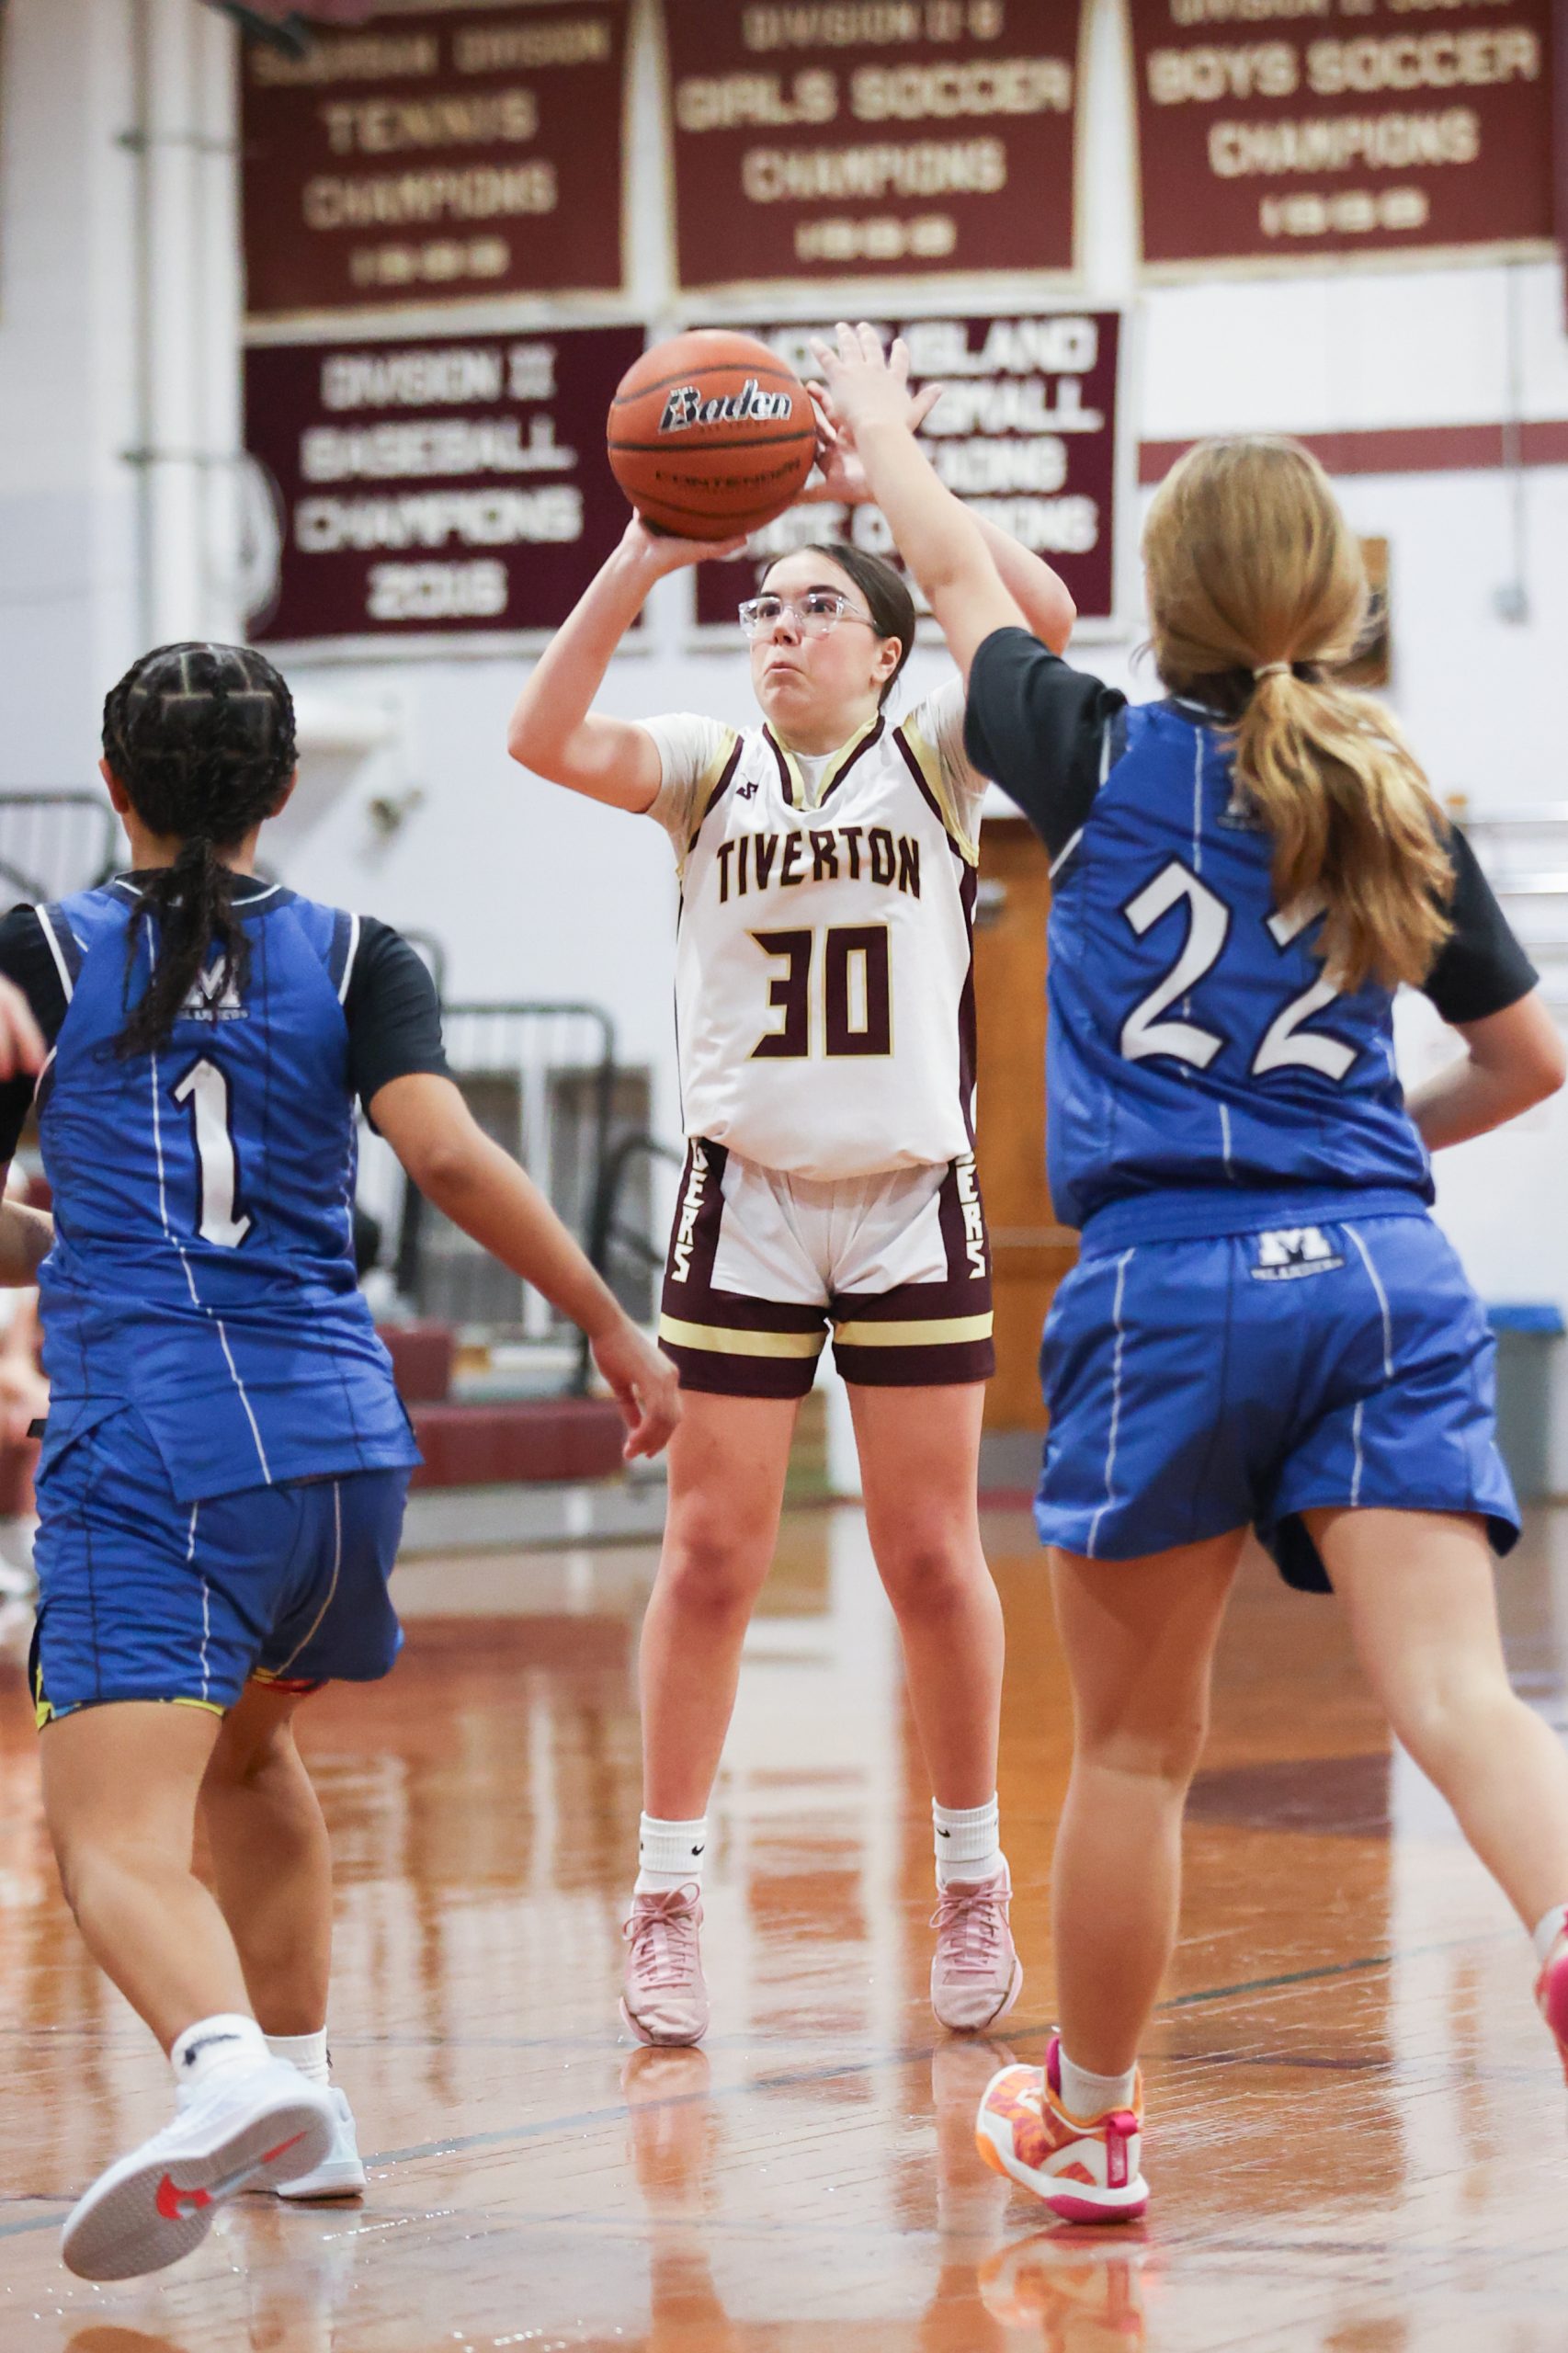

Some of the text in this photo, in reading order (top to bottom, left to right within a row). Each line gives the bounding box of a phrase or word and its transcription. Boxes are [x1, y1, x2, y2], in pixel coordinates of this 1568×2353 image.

[850, 57, 1071, 121] SOCCER
[1147, 26, 1540, 105] BOYS SOCCER
[743, 137, 1006, 203] CHAMPIONS
[1208, 107, 1480, 178] CHAMPIONS
[302, 160, 558, 230] CHAMPIONS
[320, 348, 502, 411] DIVISION
[658, 378, 792, 436] Baden
[301, 415, 577, 483] BASEBALL
[294, 484, 584, 552] CHAMPIONS
[716, 825, 922, 904] TIVERTON
[744, 921, 895, 1062] 30
[1121, 859, 1358, 1082] 22
[173, 1058, 251, 1249] 1
[671, 1138, 710, 1284] GERS
[1259, 1226, 1332, 1267] M
